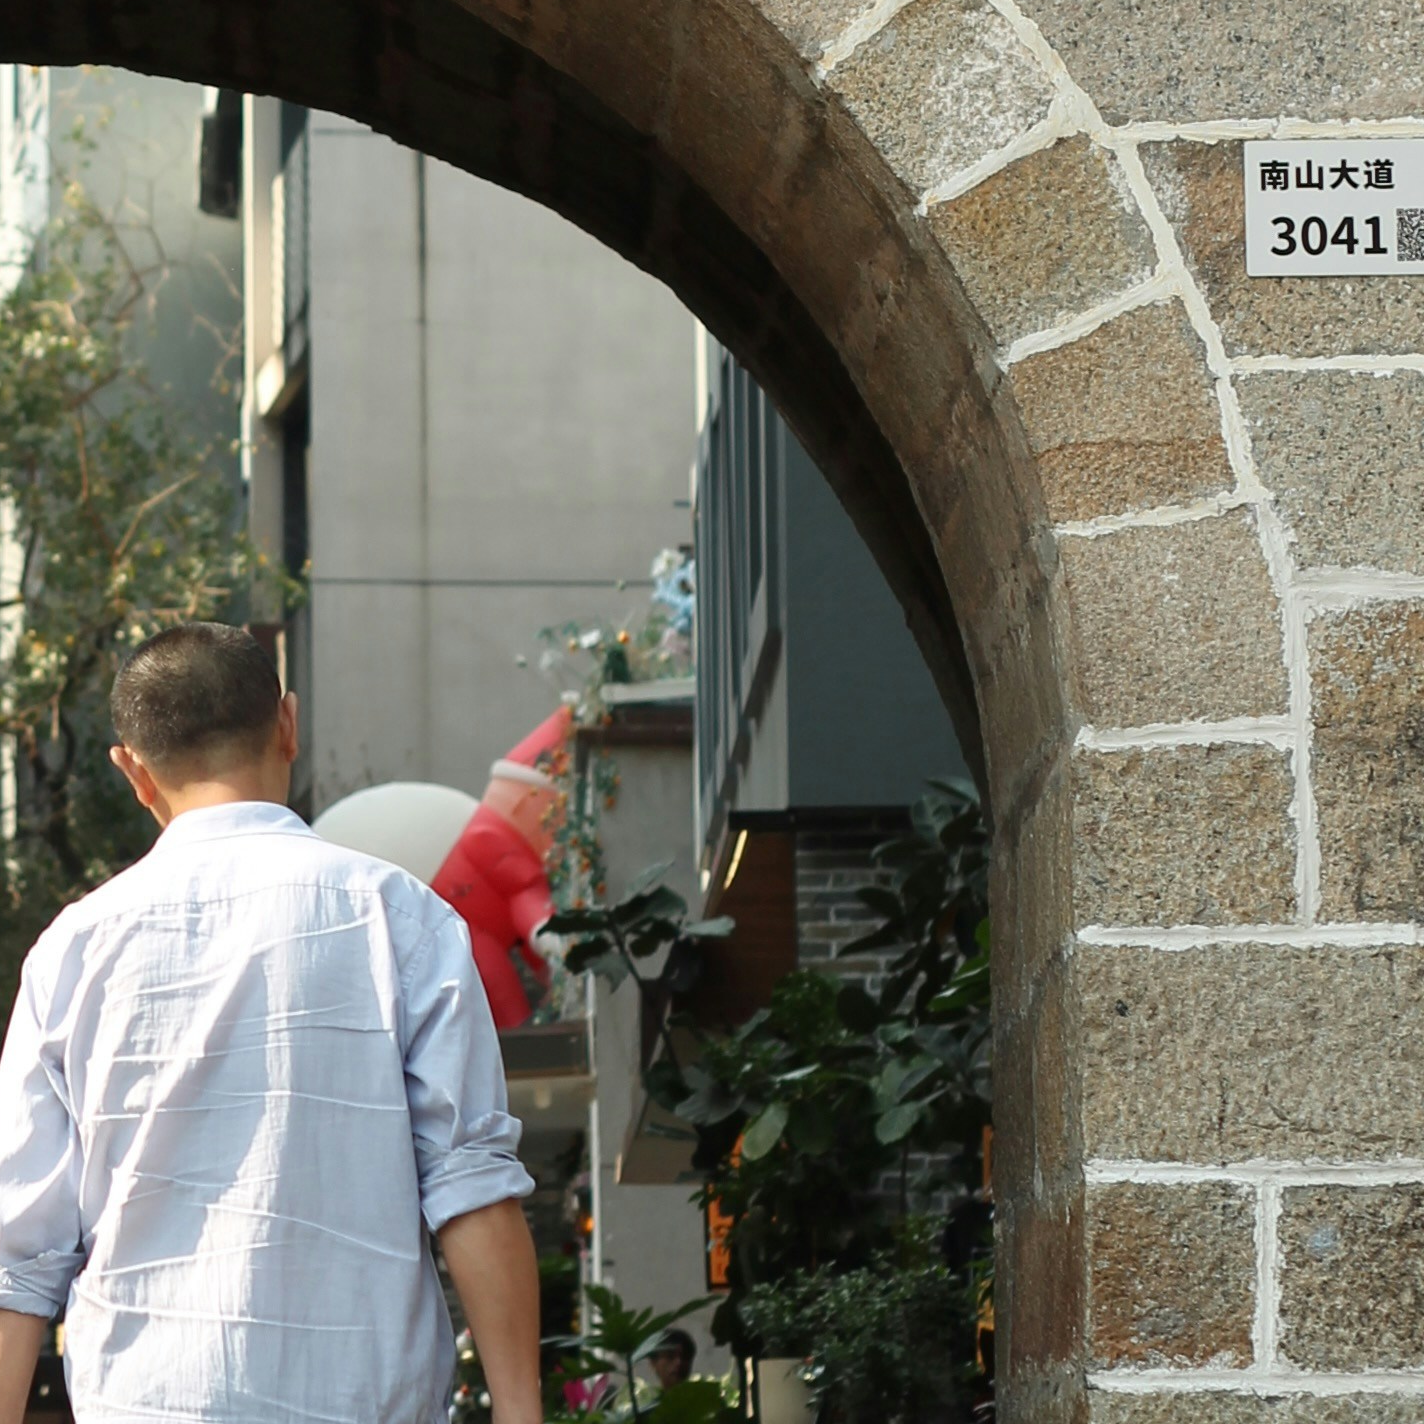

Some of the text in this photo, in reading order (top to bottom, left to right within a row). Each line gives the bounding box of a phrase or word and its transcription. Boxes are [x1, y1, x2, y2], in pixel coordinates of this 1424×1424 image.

[1259, 159, 1395, 191] 南山大道
[1270, 216, 1388, 256] 3041
